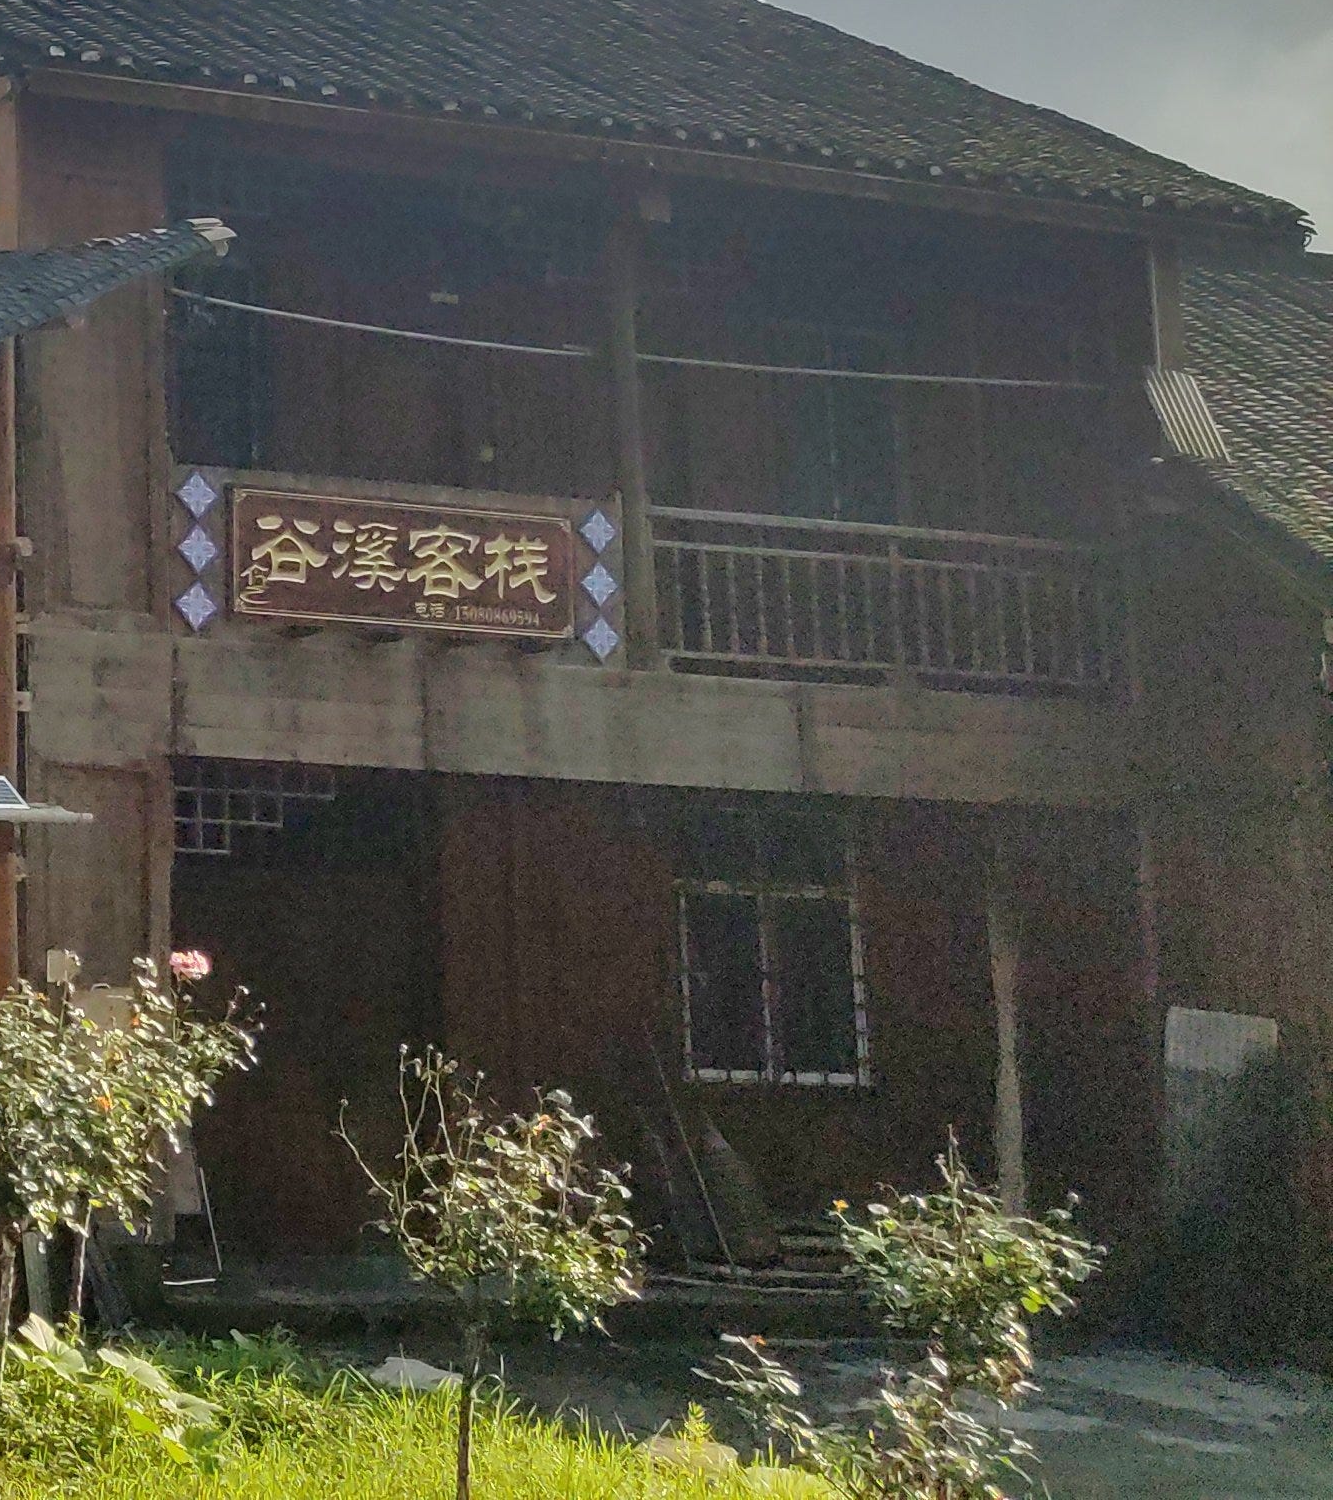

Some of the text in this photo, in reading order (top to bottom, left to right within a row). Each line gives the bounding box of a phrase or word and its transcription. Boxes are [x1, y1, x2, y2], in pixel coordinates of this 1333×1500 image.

[252, 515, 557, 604] 谷溪客栈
[414, 601, 445, 619] 电话
